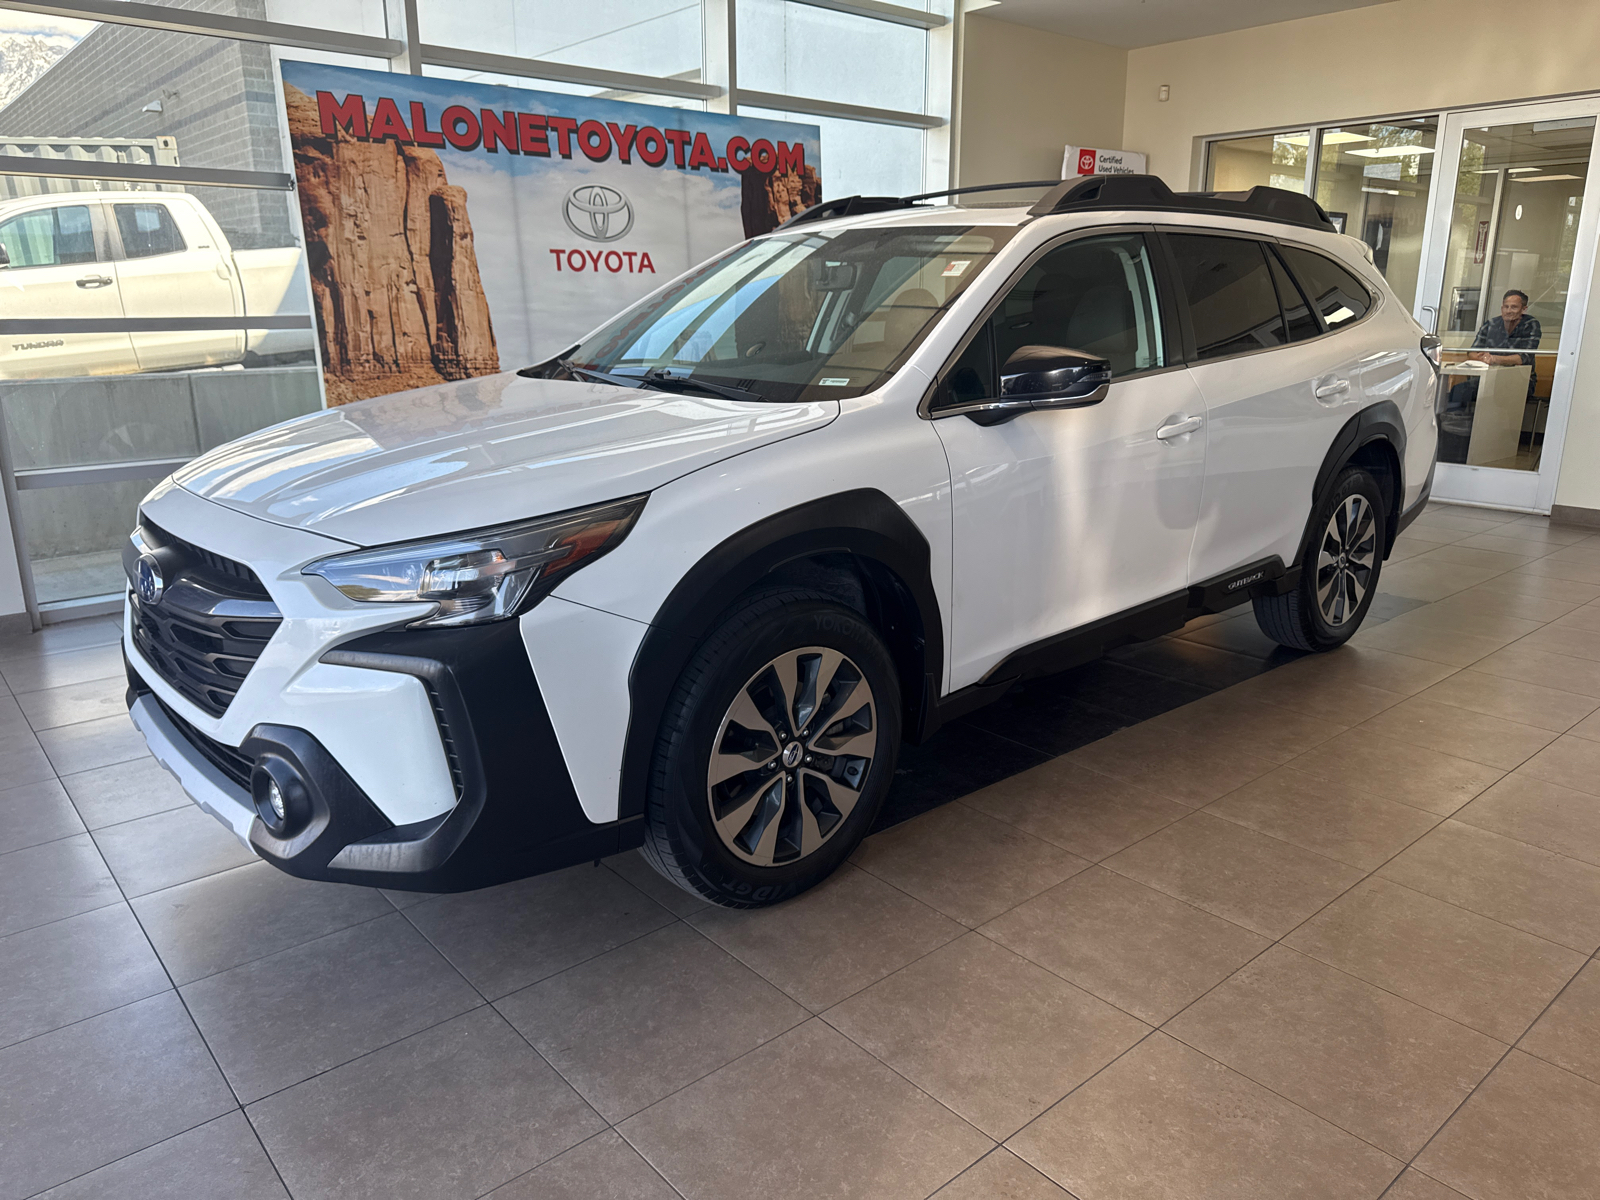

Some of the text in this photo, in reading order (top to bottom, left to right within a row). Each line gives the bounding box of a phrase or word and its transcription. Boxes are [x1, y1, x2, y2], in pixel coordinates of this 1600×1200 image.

[316, 90, 805, 176] MALONETOYOTA.COM
[1099, 155, 1123, 164] Certified
[1098, 165, 1134, 174] Used Vehicles
[549, 248, 656, 274] TOYOTA
[12, 339, 64, 351] TUNDRA
